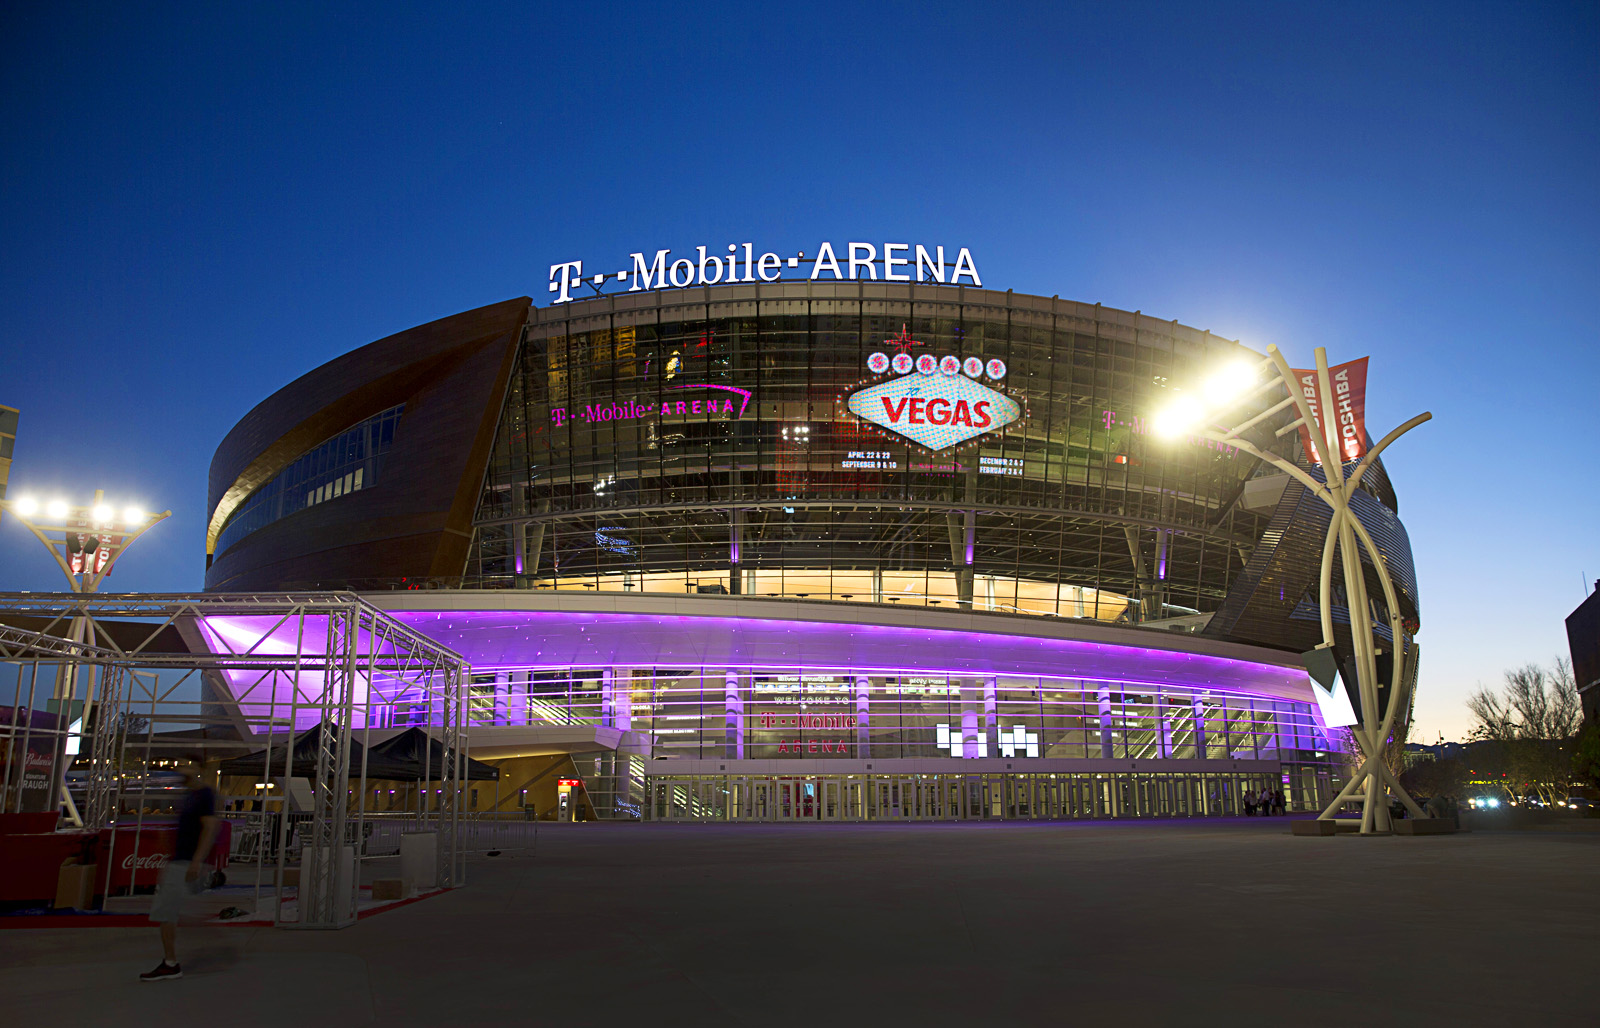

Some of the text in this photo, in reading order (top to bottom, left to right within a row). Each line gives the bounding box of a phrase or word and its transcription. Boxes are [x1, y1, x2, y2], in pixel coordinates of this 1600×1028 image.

[810, 242, 982, 287] ARENA
[660, 398, 734, 416] ARENA
[881, 396, 992, 428] VEGAS
[1335, 368, 1359, 450] TOSHIBA
[847, 451, 865, 459] APRIL
[774, 696, 830, 705] WELCOME
[778, 739, 848, 753] ARENA
